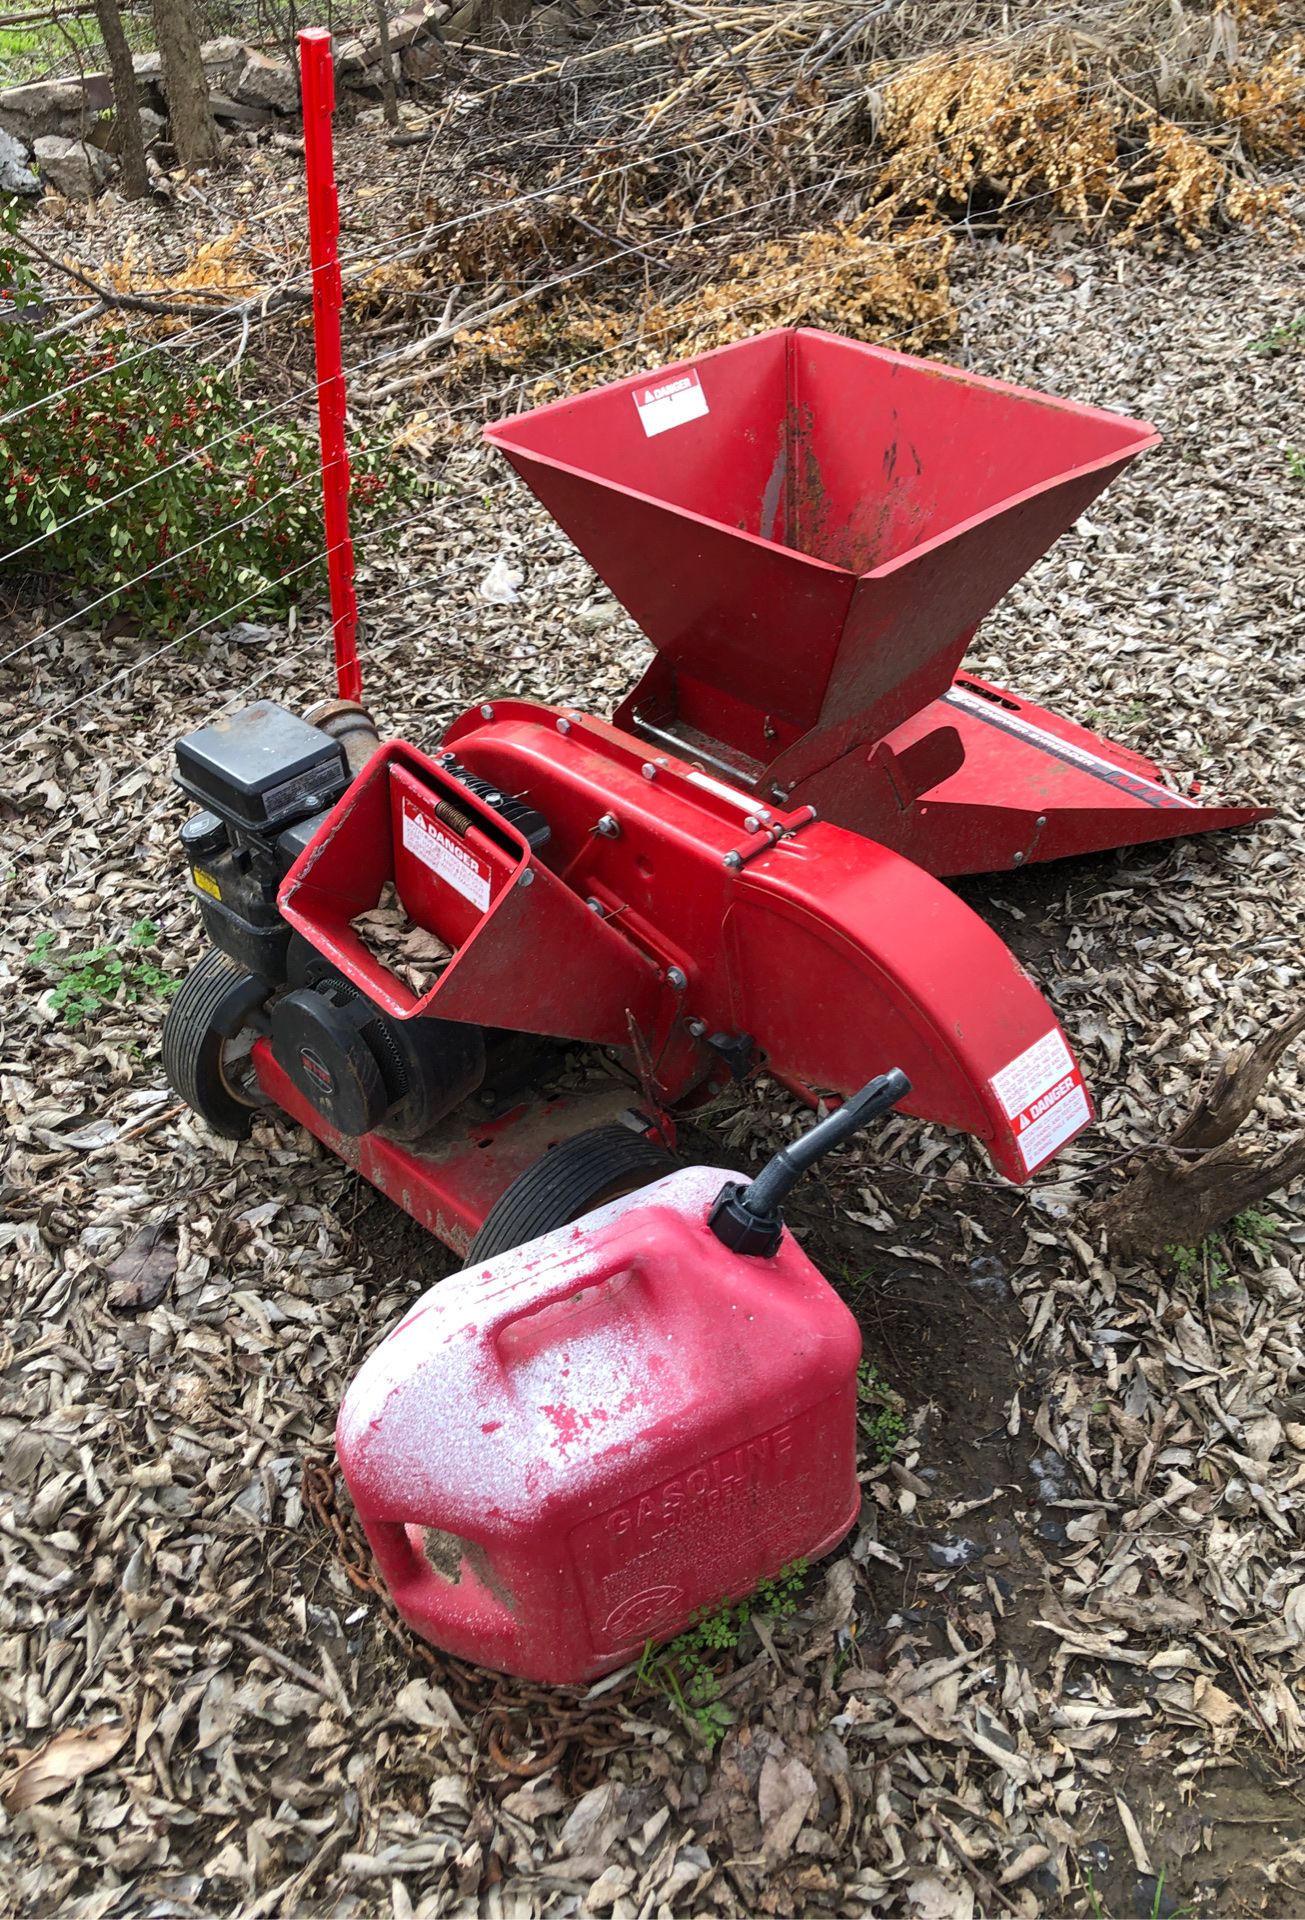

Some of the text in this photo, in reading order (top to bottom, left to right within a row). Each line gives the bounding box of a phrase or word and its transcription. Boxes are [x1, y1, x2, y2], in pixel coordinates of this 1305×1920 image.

[652, 377, 692, 400] DANGER
[428, 823, 480, 874] DANGER
[1029, 1076, 1075, 1120] DANGER
[604, 1424, 794, 1536] GASOLINE
